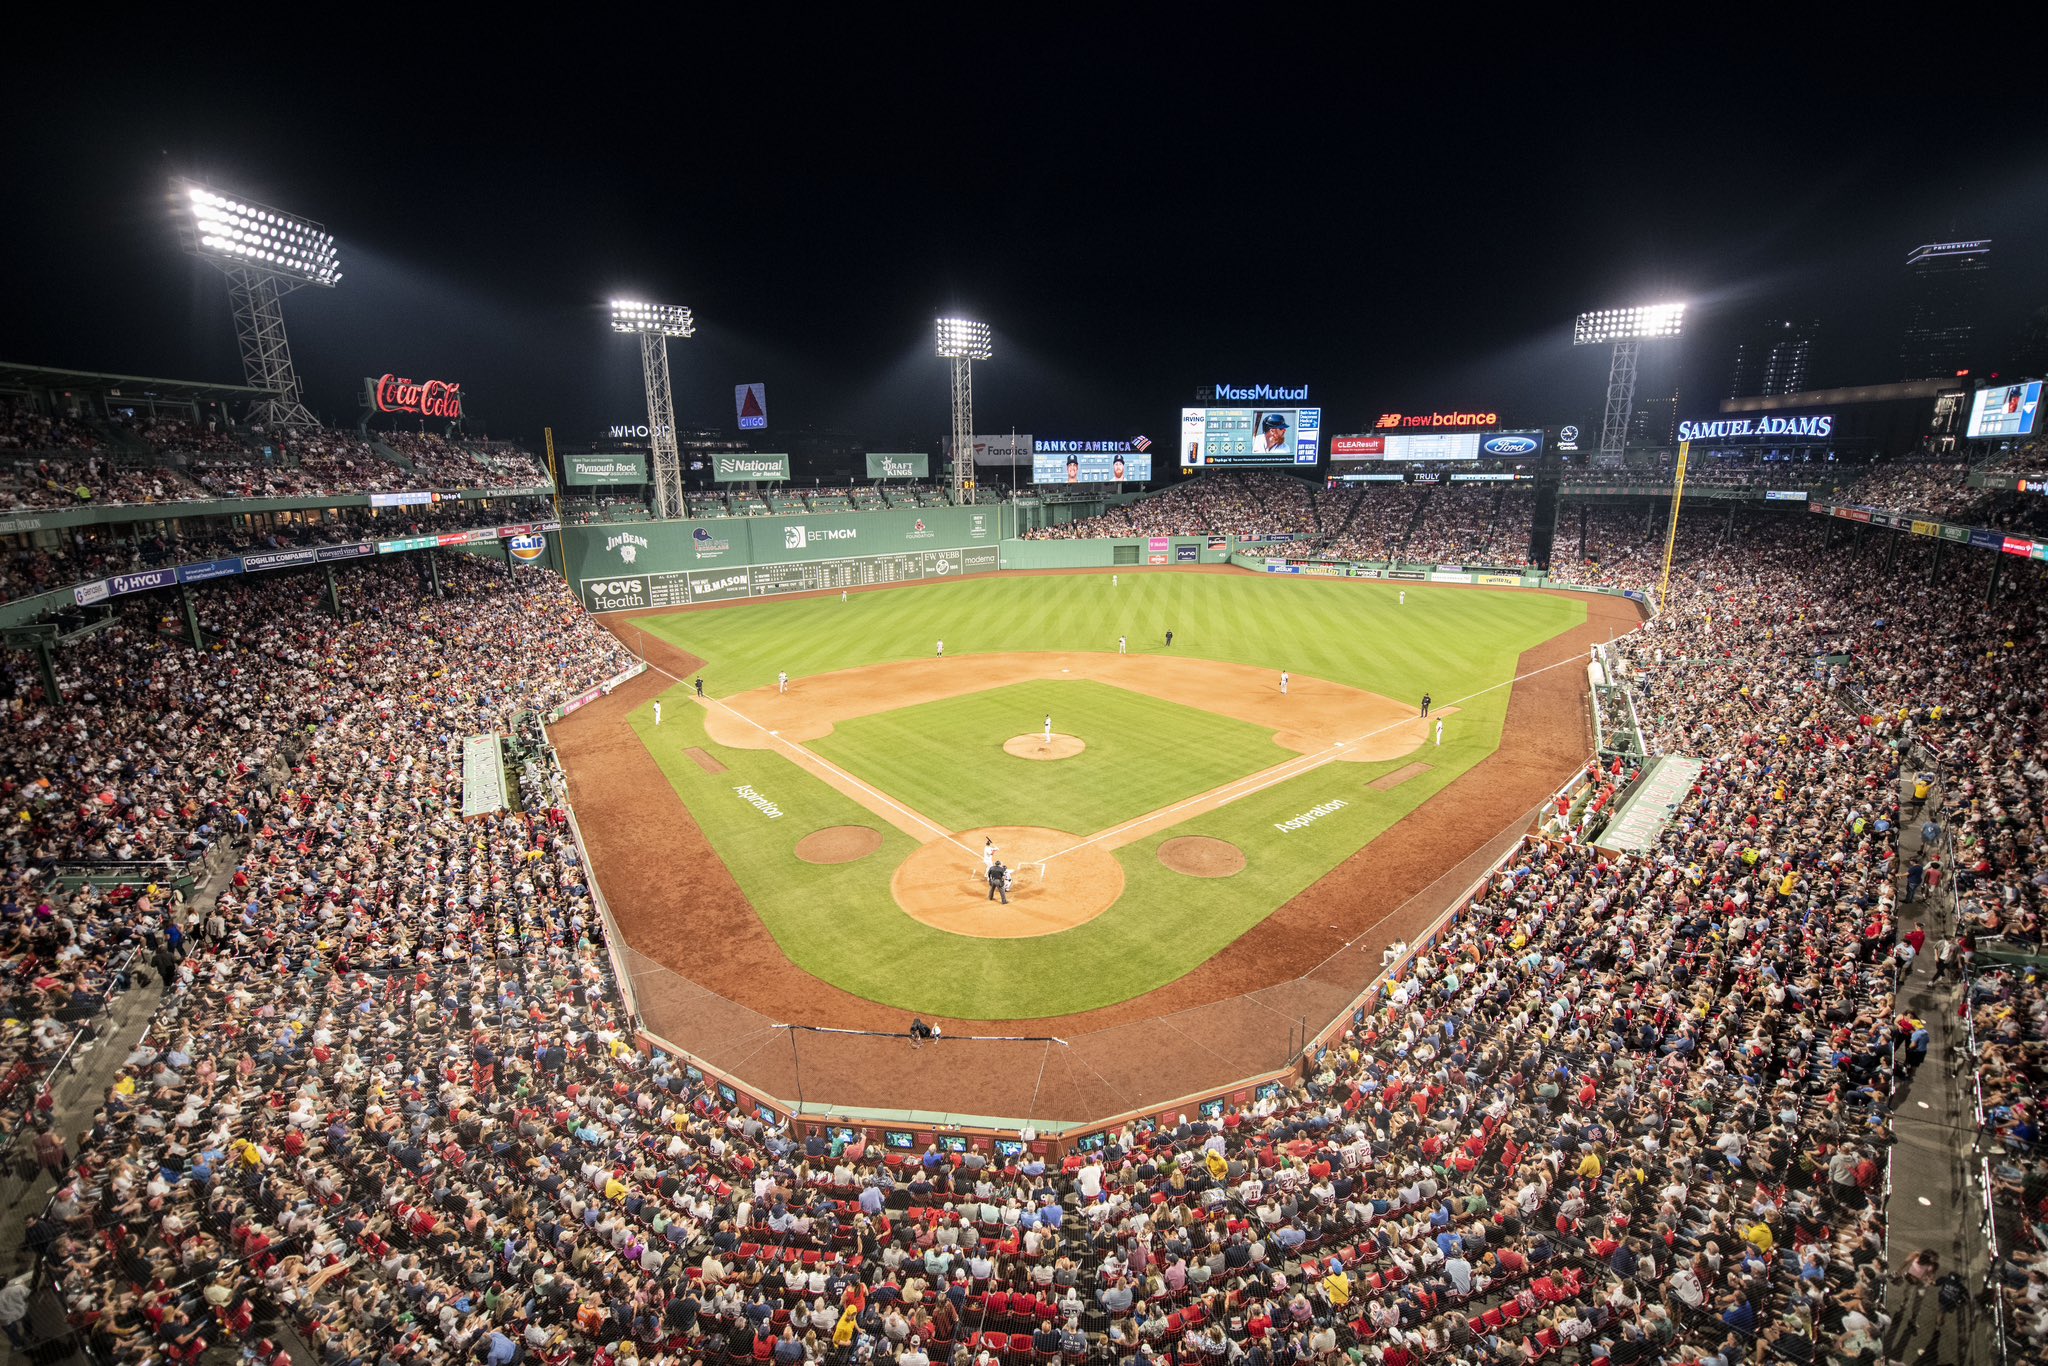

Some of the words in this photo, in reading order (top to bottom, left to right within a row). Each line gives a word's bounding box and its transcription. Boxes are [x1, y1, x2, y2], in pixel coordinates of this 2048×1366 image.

[377, 373, 460, 418] Coca-Cola
[1215, 384, 1308, 400] MassMutual
[740, 417, 764, 427] CITGO
[611, 425, 671, 437] WHOOP
[1678, 420, 1754, 441] SAMUEL
[1754, 416, 1832, 436] ADAMS
[988, 446, 1028, 456] Fanaics
[1035, 441, 1067, 451] BANK
[1069, 441, 1083, 451] OF
[1084, 441, 1131, 451] AMERICA
[1494, 439, 1525, 452] Ford
[575, 463, 615, 473] Plymouth
[616, 463, 637, 471] Rock
[883, 462, 913, 471] DRAFT
[808, 528, 857, 541] BETMGM
[511, 537, 545, 549] Gulf
[606, 536, 623, 551] JIM
[622, 532, 648, 549] BEAM
[247, 556, 277, 567] COGHLIN
[277, 552, 314, 563] COMPANIES
[319, 550, 342, 559] vineyard
[342, 548, 359, 557] vines
[937, 551, 960, 559] WEBB
[965, 555, 995, 564] moderna
[130, 574, 161, 588] HYCU
[608, 580, 642, 595] CVS
[594, 594, 644, 609] Health
[732, 784, 784, 819] Aspiration
[1274, 799, 1348, 833] Aspiration
[1360, 1148, 1371, 1157] 22
[1347, 1155, 1354, 1164] 11
[1282, 1179, 1294, 1188] 27
[1250, 1191, 1258, 1199] 11
